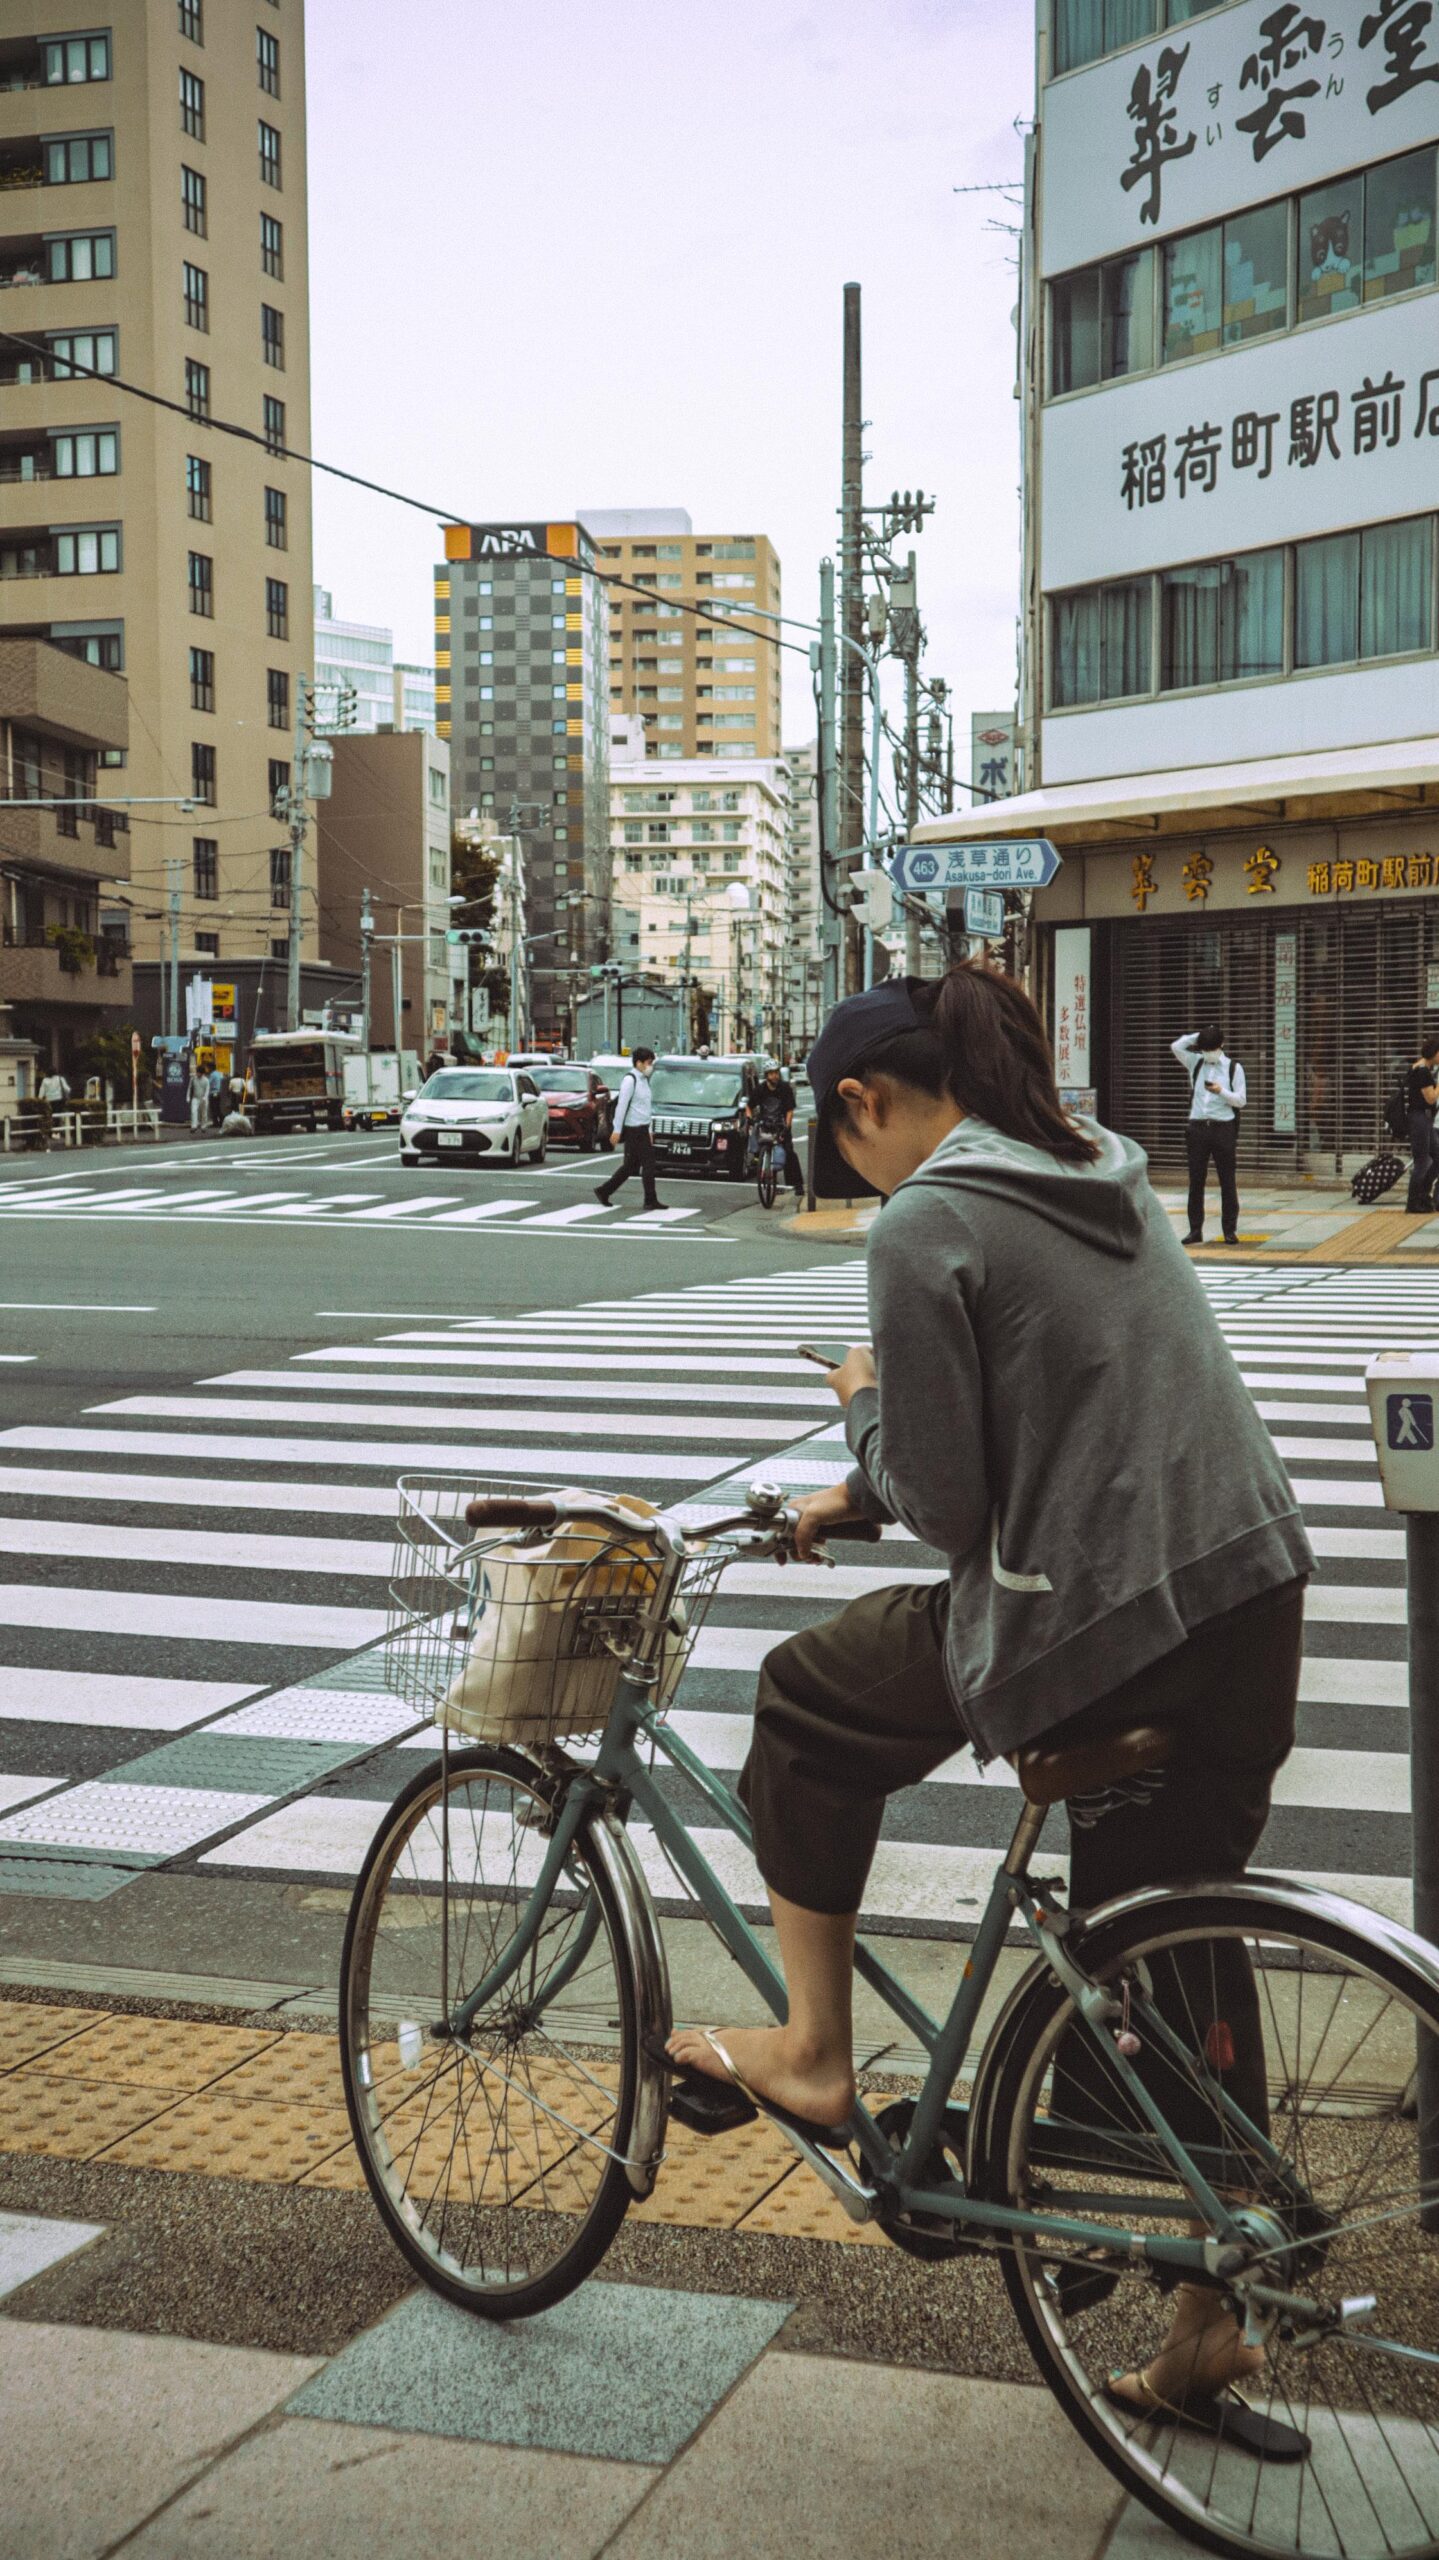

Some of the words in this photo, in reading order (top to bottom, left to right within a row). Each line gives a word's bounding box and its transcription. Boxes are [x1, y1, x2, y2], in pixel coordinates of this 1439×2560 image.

[1325, 32, 1345, 100] うん
[1205, 81, 1224, 147] すい
[480, 529, 537, 554] APA
[913, 860, 936, 875] 463
[945, 867, 1012, 882] Asakusa-dori
[1016, 867, 1037, 880] Ave.
[948, 847, 1032, 868] 浅草通り
[1074, 974, 1087, 1050] 特選仏壇
[1058, 1006, 1071, 1081] 多数展示
